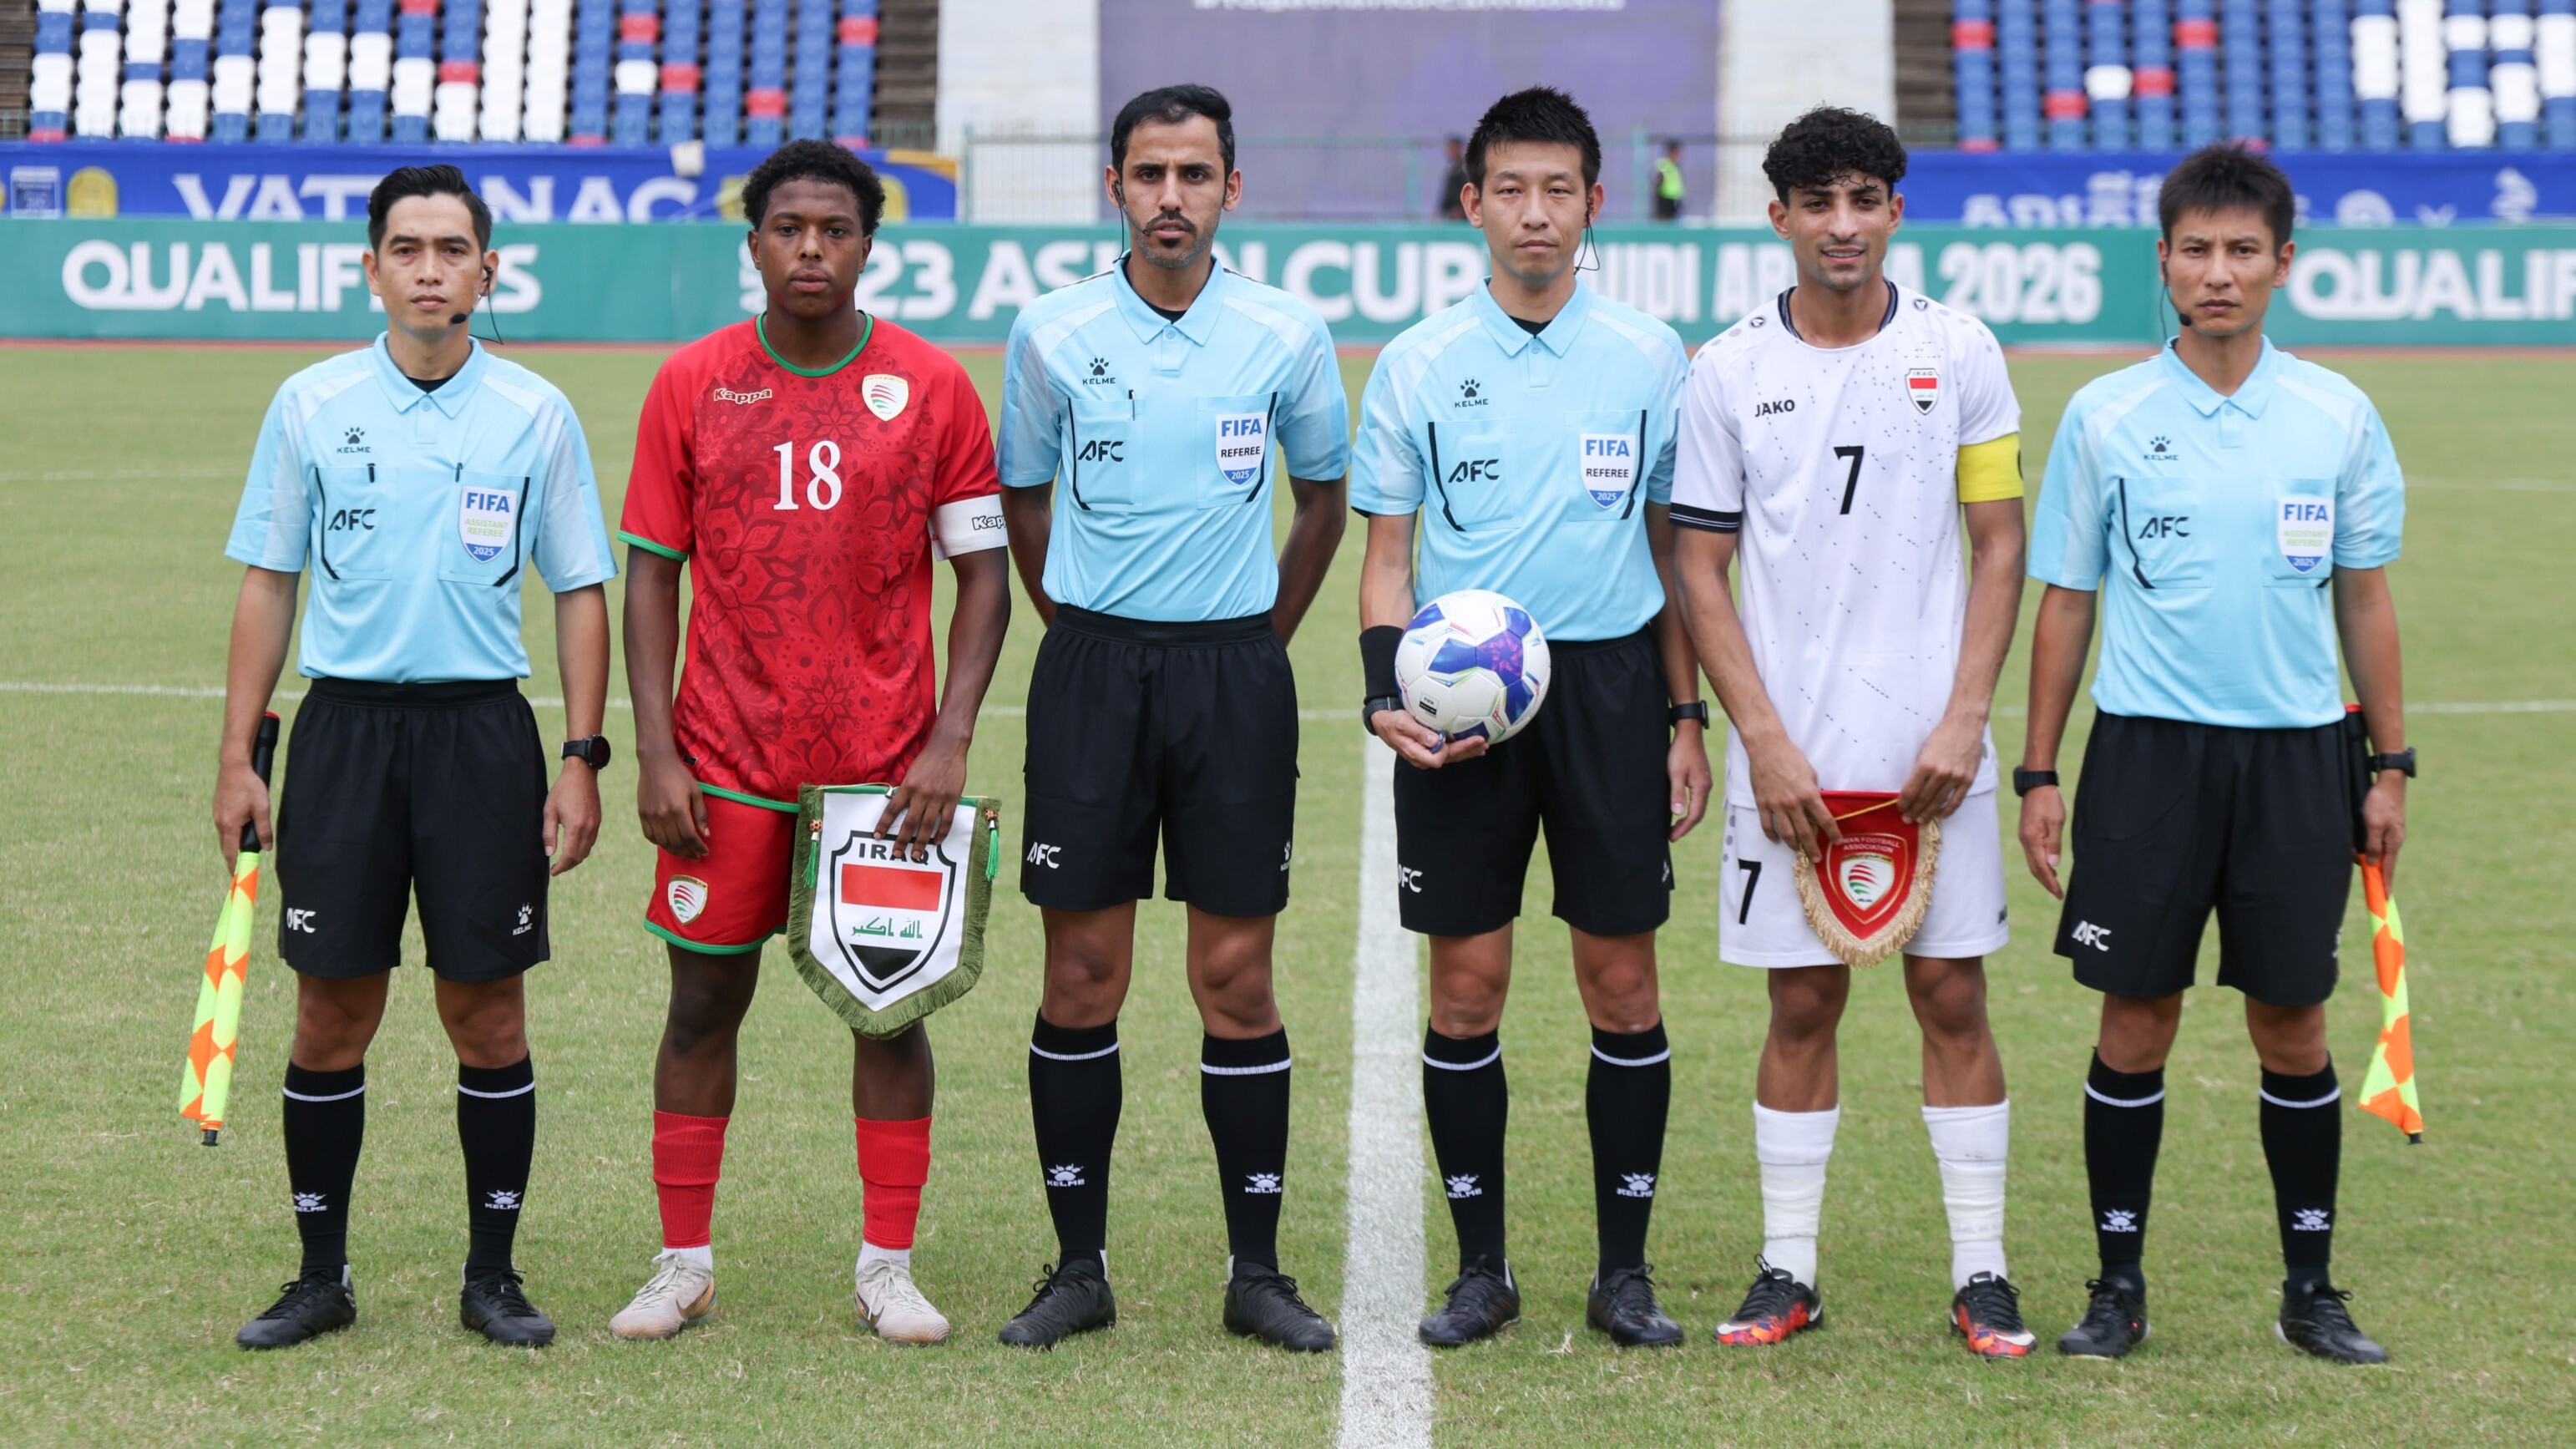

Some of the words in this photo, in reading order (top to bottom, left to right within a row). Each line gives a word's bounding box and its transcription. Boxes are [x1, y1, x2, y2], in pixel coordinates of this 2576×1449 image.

[171, 174, 699, 224] VATNAC
[62, 239, 541, 314] QUALIFS
[1282, 240, 1488, 323] CUP
[1938, 241, 2103, 324] 2026
[713, 388, 772, 404] Kappa
[1455, 398, 1489, 408] KELME
[1754, 399, 1795, 418] JAKO
[1221, 418, 1262, 437] FIFA
[1078, 440, 1124, 462] AFC
[1221, 446, 1261, 458] REFEREE
[1586, 439, 1630, 457] FIFA
[773, 440, 842, 510] 18
[1232, 470, 1249, 479] 2025
[1448, 459, 1500, 483] AFC
[1586, 468, 1629, 478] REFEREE
[1834, 445, 1864, 515] 7
[466, 492, 510, 513] FIFA
[1597, 493, 1617, 501] 2025
[328, 509, 376, 531] AFC
[2284, 504, 2329, 522] FIFA
[464, 519, 509, 528] ASSISTANT
[971, 514, 1005, 530] Kap
[2138, 516, 2190, 540] AFC
[468, 527, 504, 537] REFEREE
[473, 546, 494, 556] 2025
[2294, 558, 2315, 566] 2025
[1844, 844, 1894, 853] ASSOCIATION
[1861, 837, 1900, 849] FOOTBALL
[1026, 841, 1061, 869] AFC
[1738, 859, 1762, 925] 7
[513, 923, 533, 935] KELME
[2071, 920, 2112, 951] AFC
[1047, 1178, 1085, 1187] KELME
[1447, 1188, 1482, 1198] KELME
[1617, 1188, 1653, 1198] KELME
